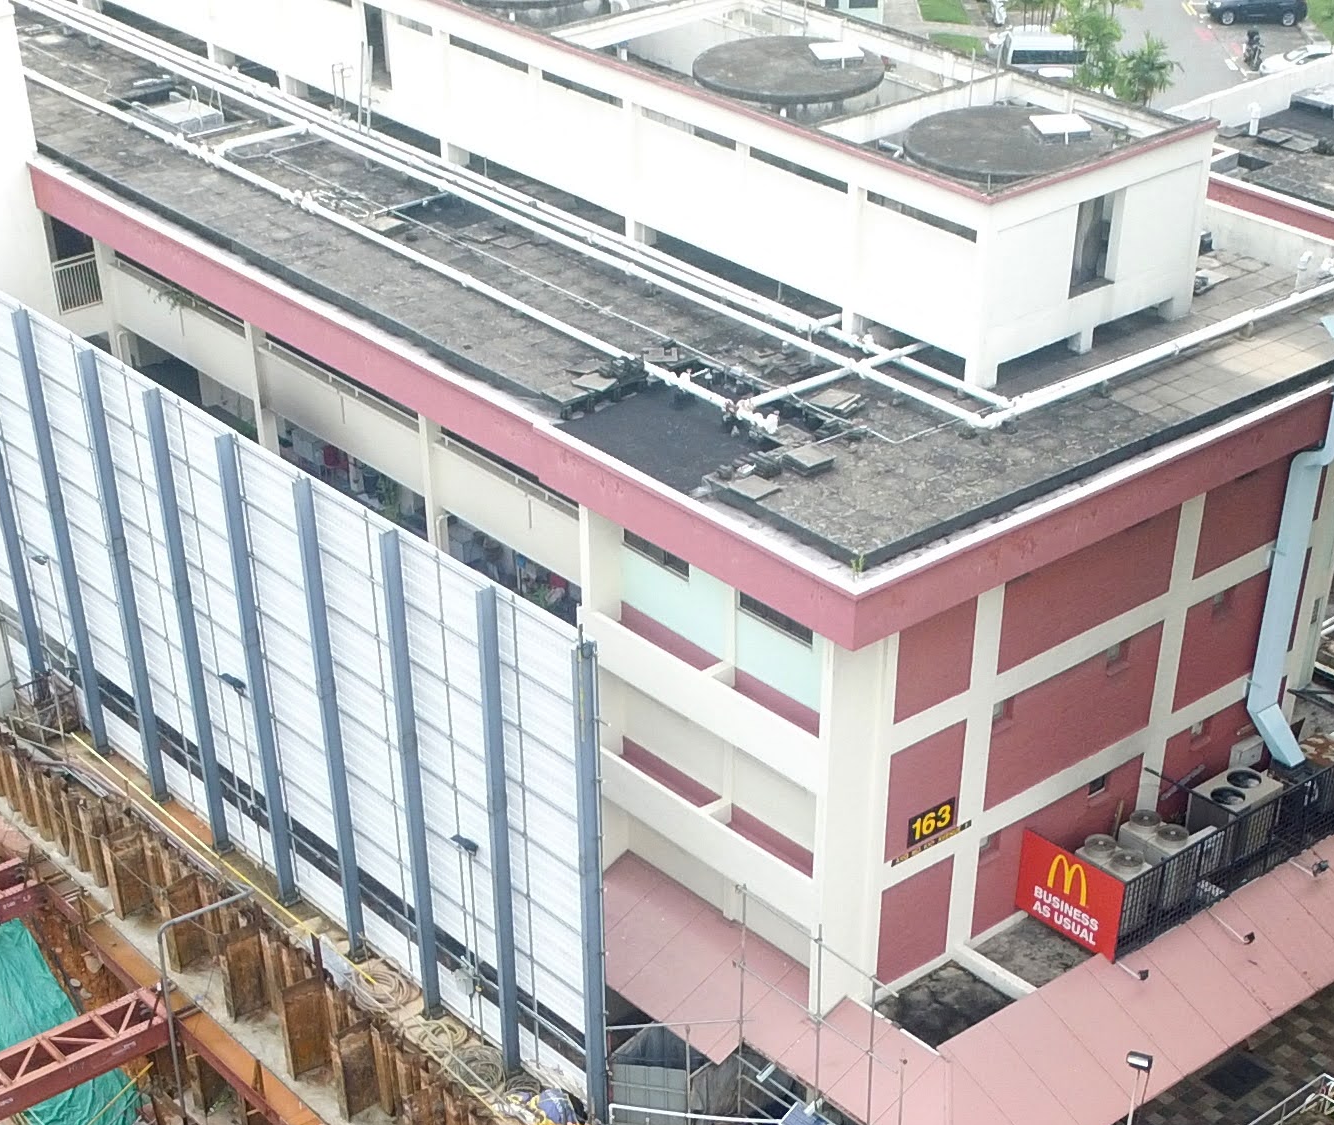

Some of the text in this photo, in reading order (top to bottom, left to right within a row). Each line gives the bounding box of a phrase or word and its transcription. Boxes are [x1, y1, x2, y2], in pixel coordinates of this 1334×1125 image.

[912, 804, 951, 840] 163
[1032, 900, 1096, 946] AS USUAL
[1033, 885, 1099, 931] BUSINESS
